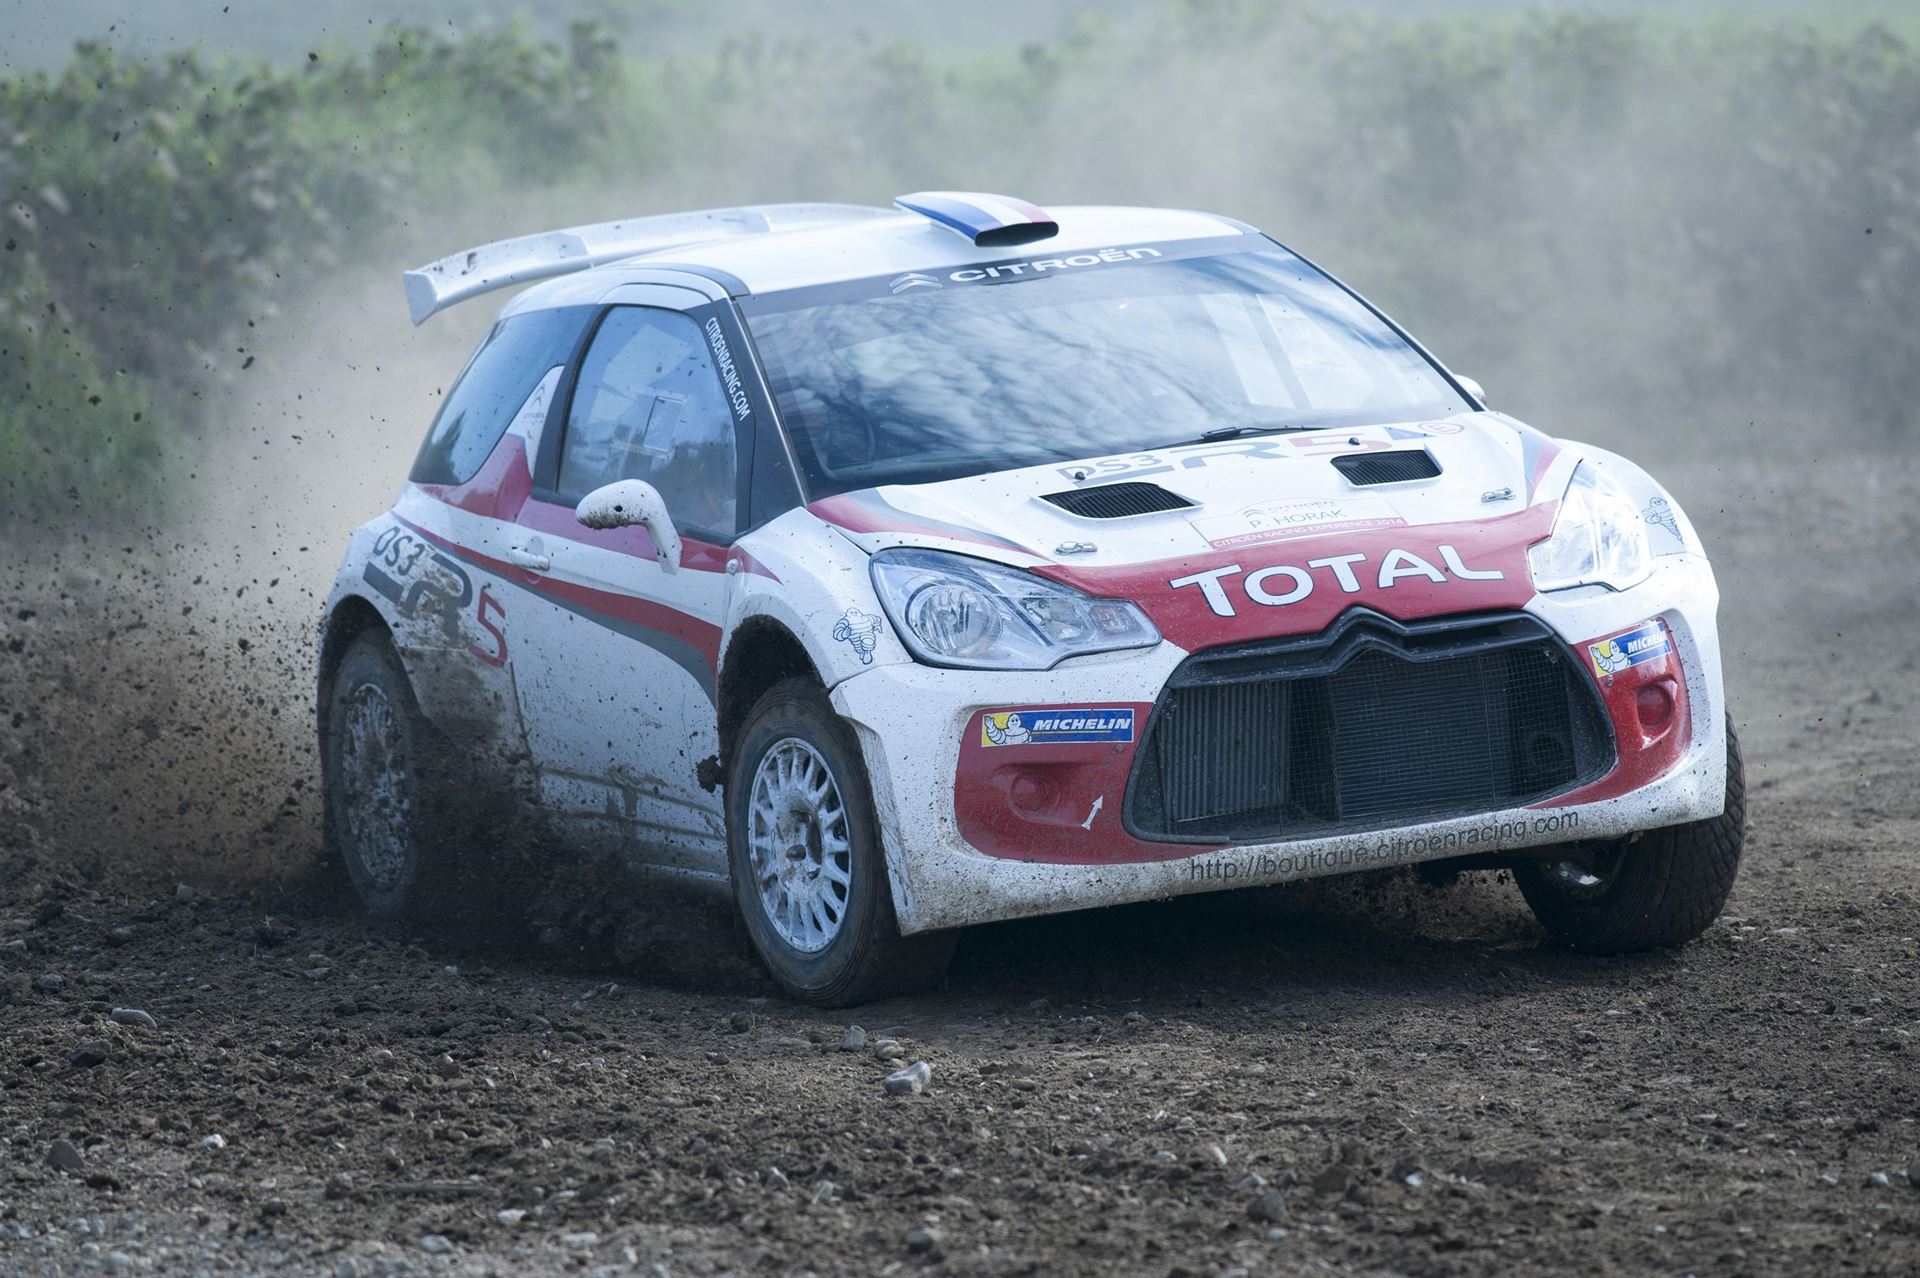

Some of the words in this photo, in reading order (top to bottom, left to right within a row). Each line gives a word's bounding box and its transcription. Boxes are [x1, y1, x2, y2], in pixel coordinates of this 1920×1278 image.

[705, 316, 751, 421] CITROENRACING.COM
[1056, 455, 1162, 481] DS3
[1263, 525, 1307, 540] RACING
[1308, 520, 1375, 532] EXPERIENCE
[1375, 518, 1405, 527] 2014
[372, 526, 425, 576] DS3
[1168, 544, 1505, 617] TOTAL
[1033, 718, 1131, 731] MICHELIN
